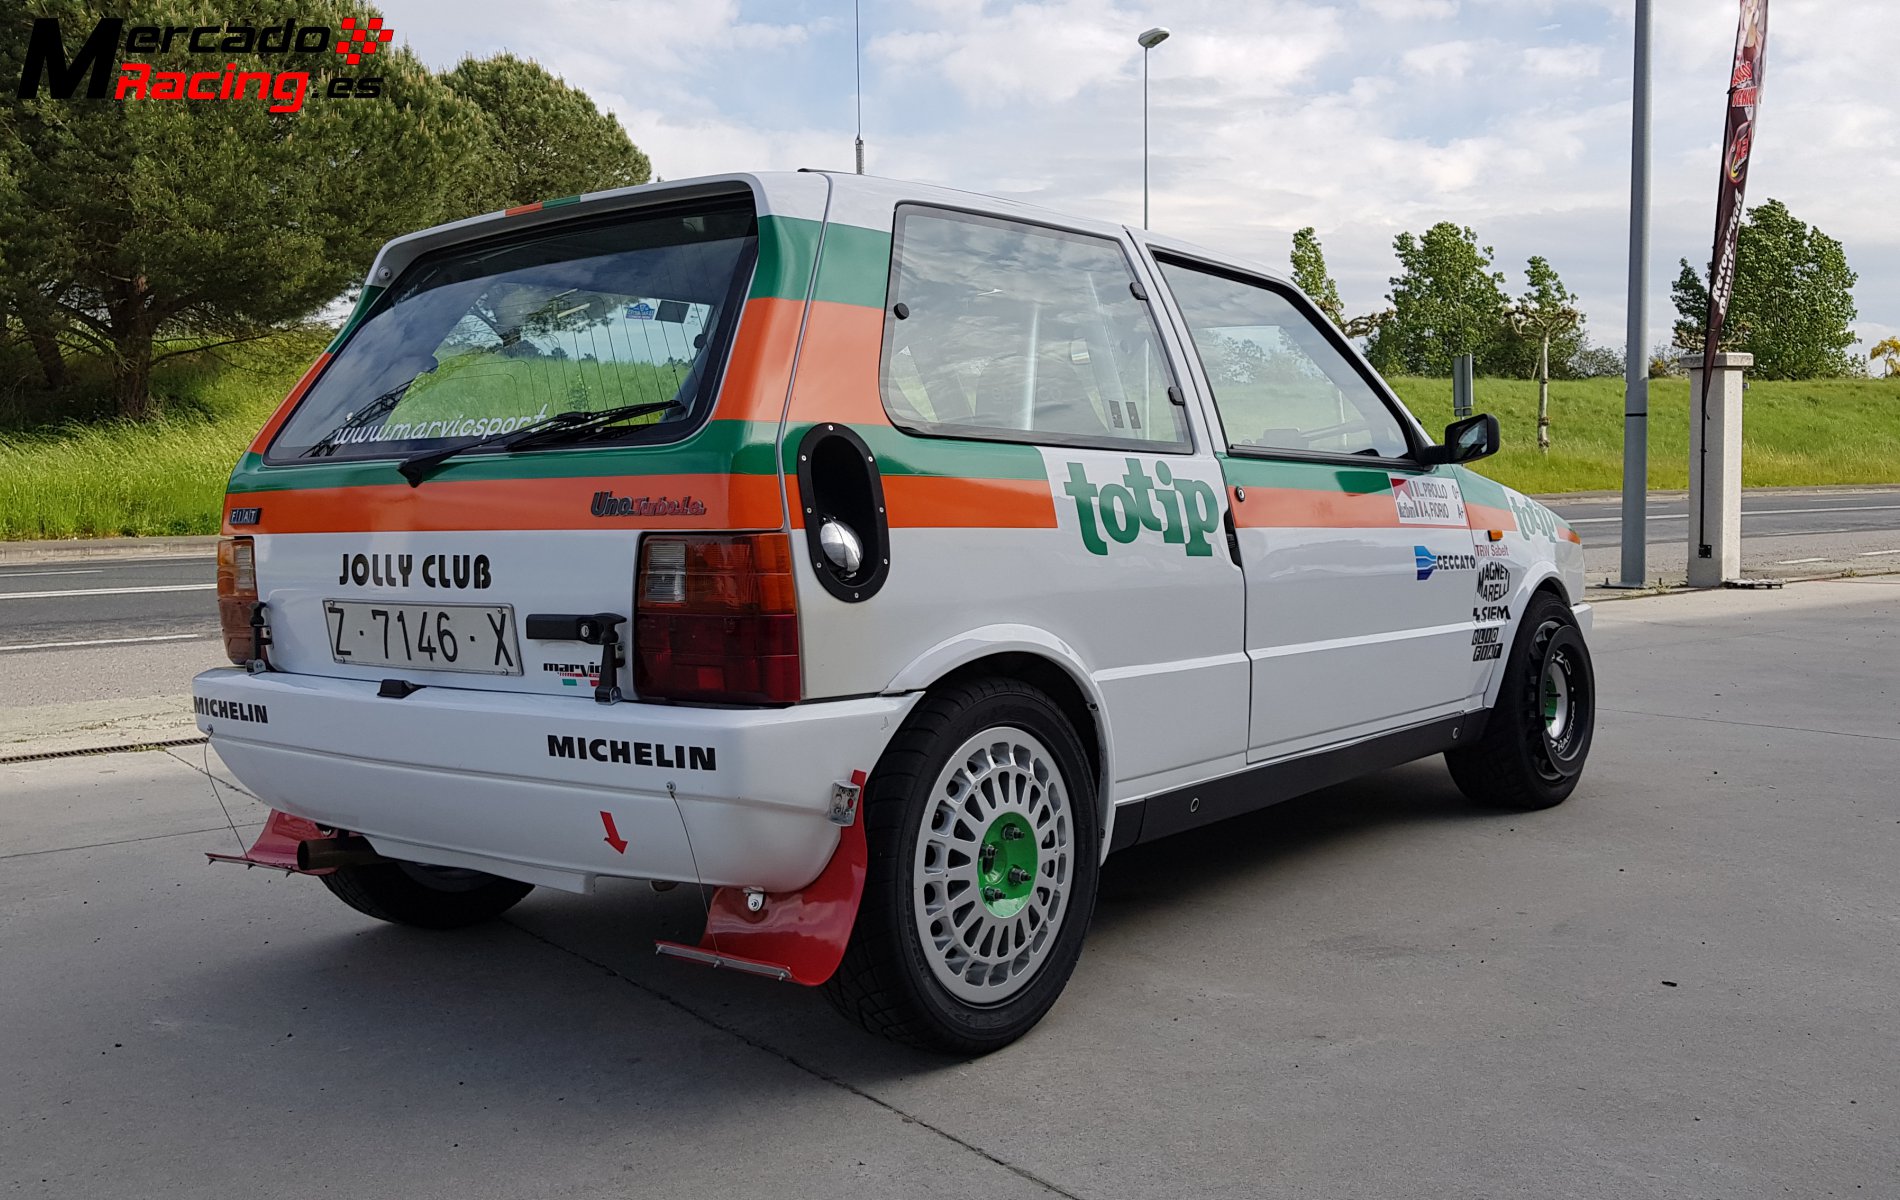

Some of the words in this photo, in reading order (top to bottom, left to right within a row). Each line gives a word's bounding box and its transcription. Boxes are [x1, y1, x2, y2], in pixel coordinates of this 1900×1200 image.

[590, 490, 634, 517] Uno
[1063, 457, 1220, 557] totip
[231, 510, 257, 523] FIAT
[1436, 554, 1476, 570] CECCATO
[1475, 544, 1490, 557] TRW
[339, 553, 413, 588] JOLLY
[421, 554, 492, 589] CLUB
[1476, 582, 1510, 602] MARELLI
[1473, 643, 1503, 661] FIAT
[193, 696, 268, 724] MICHELIN
[547, 734, 717, 771] MICHELIN
